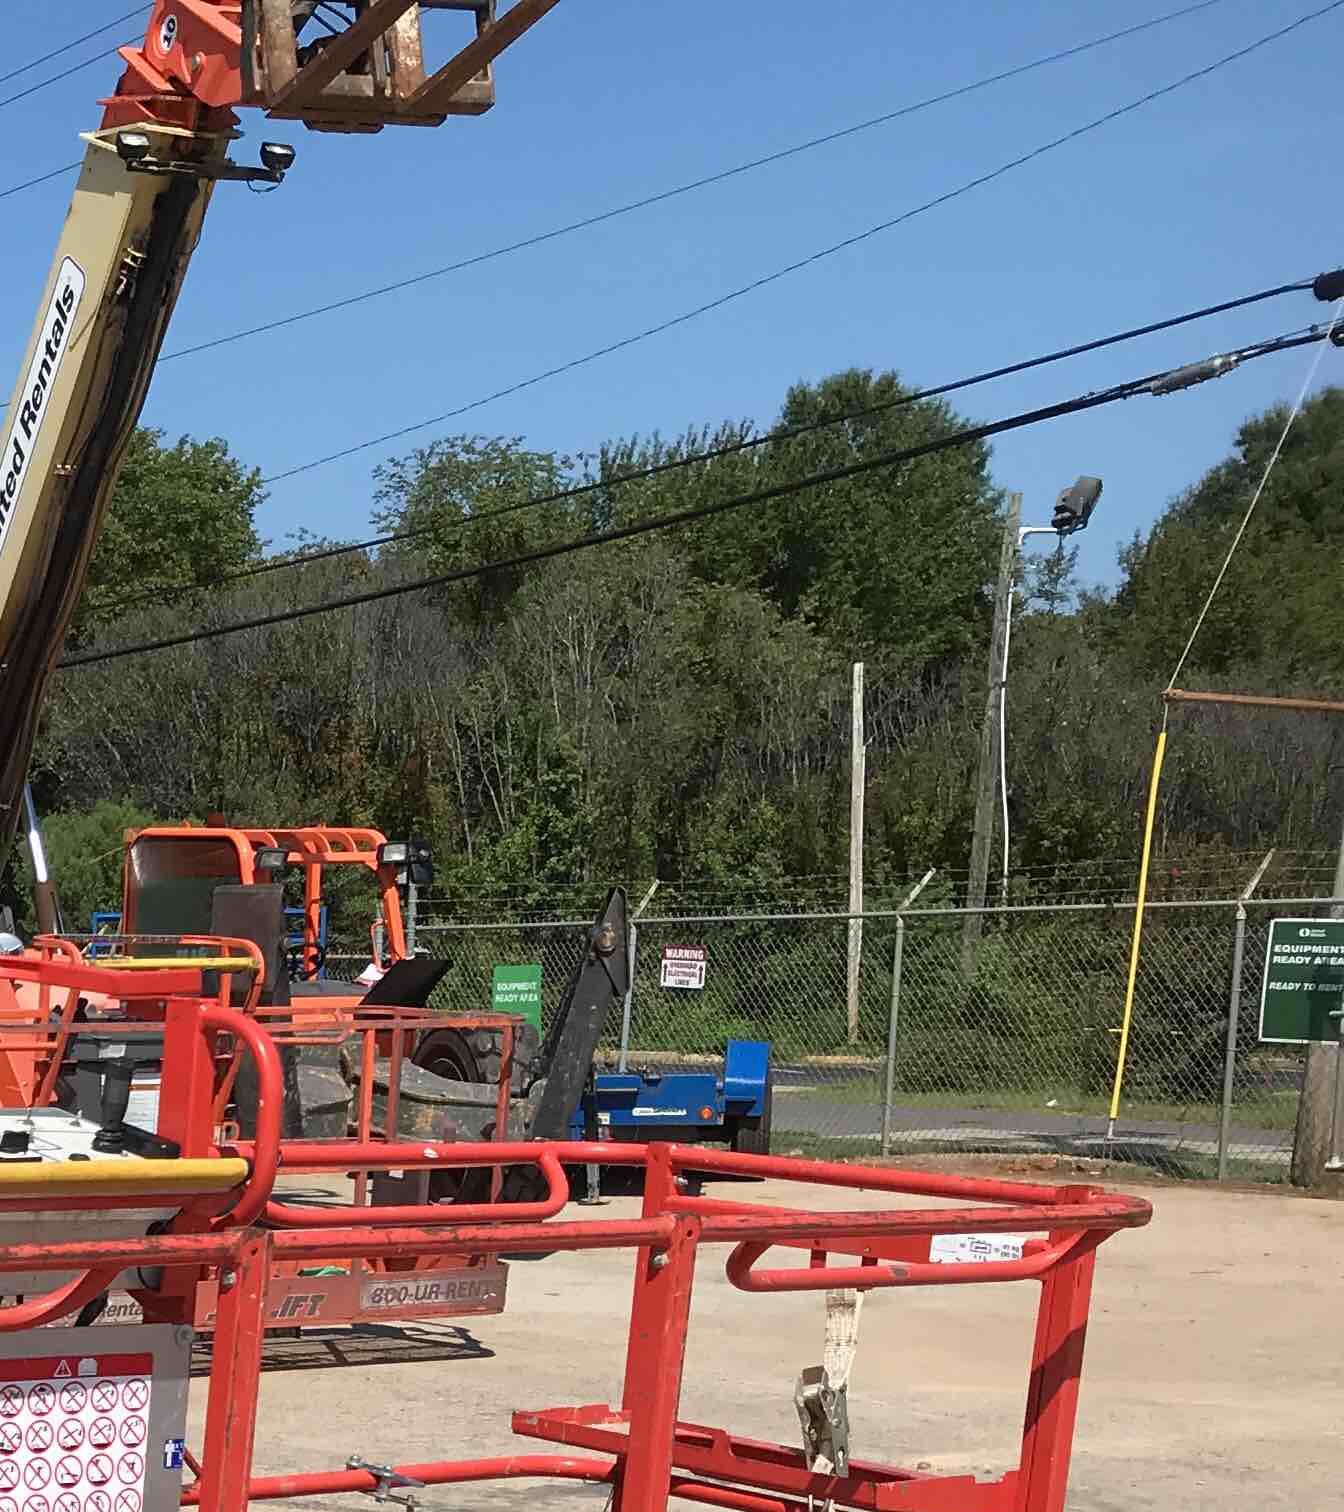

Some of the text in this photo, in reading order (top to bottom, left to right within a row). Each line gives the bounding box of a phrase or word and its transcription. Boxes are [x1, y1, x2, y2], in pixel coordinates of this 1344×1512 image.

[163, 17, 176, 49] 10
[19, 284, 74, 440] Rentals
[665, 948, 704, 960] WARNING
[1272, 955, 1312, 964] READY
[1269, 982, 1302, 991] READY
[1303, 982, 1317, 991] TO
[270, 1293, 328, 1319] IFT
